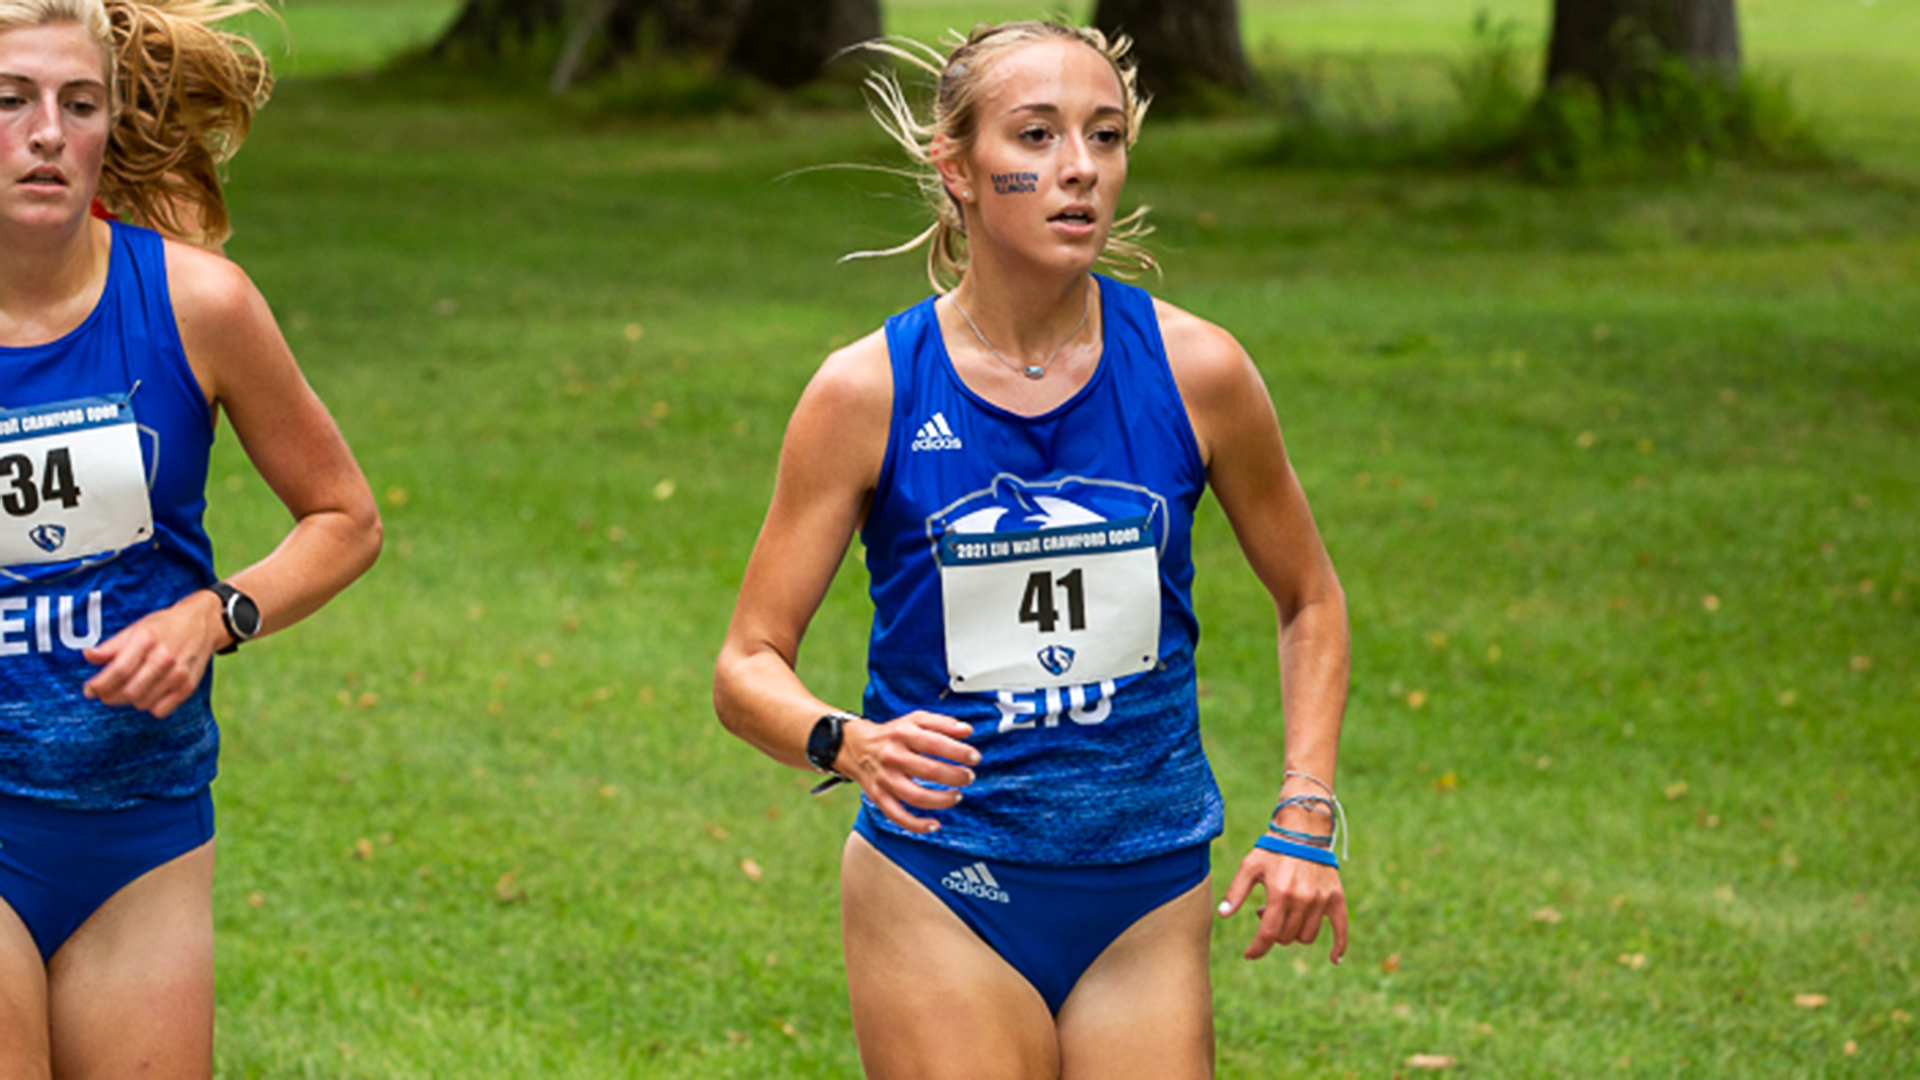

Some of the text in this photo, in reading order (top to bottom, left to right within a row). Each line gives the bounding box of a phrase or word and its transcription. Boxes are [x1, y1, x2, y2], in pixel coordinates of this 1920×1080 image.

[911, 437, 963, 452] adidas
[0, 447, 81, 518] 34
[957, 543, 988, 559] 2021
[1043, 531, 1107, 551] CRAWFORD
[0, 590, 102, 657] EIU
[1018, 568, 1087, 633] 41
[941, 876, 1010, 904] adidas
